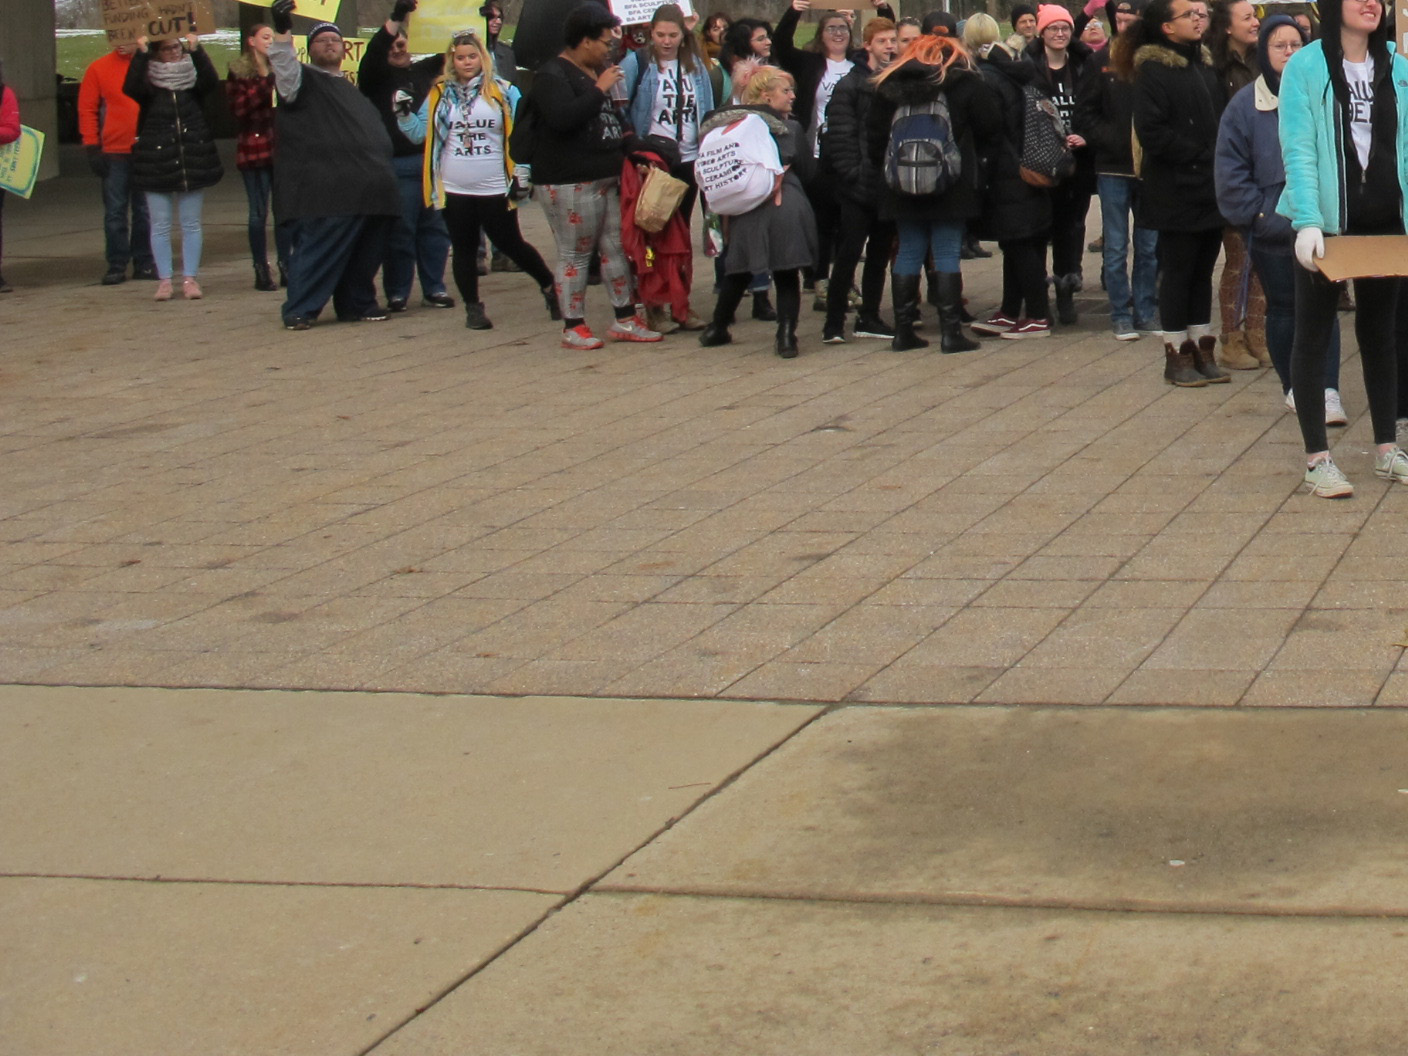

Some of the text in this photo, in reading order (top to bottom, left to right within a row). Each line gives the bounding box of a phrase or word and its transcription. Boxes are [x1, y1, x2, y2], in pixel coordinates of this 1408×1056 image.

[148, 12, 198, 36] CUT!
[342, 40, 364, 62] RT
[455, 145, 492, 156] ARTS
[717, 151, 736, 161] ARTS
